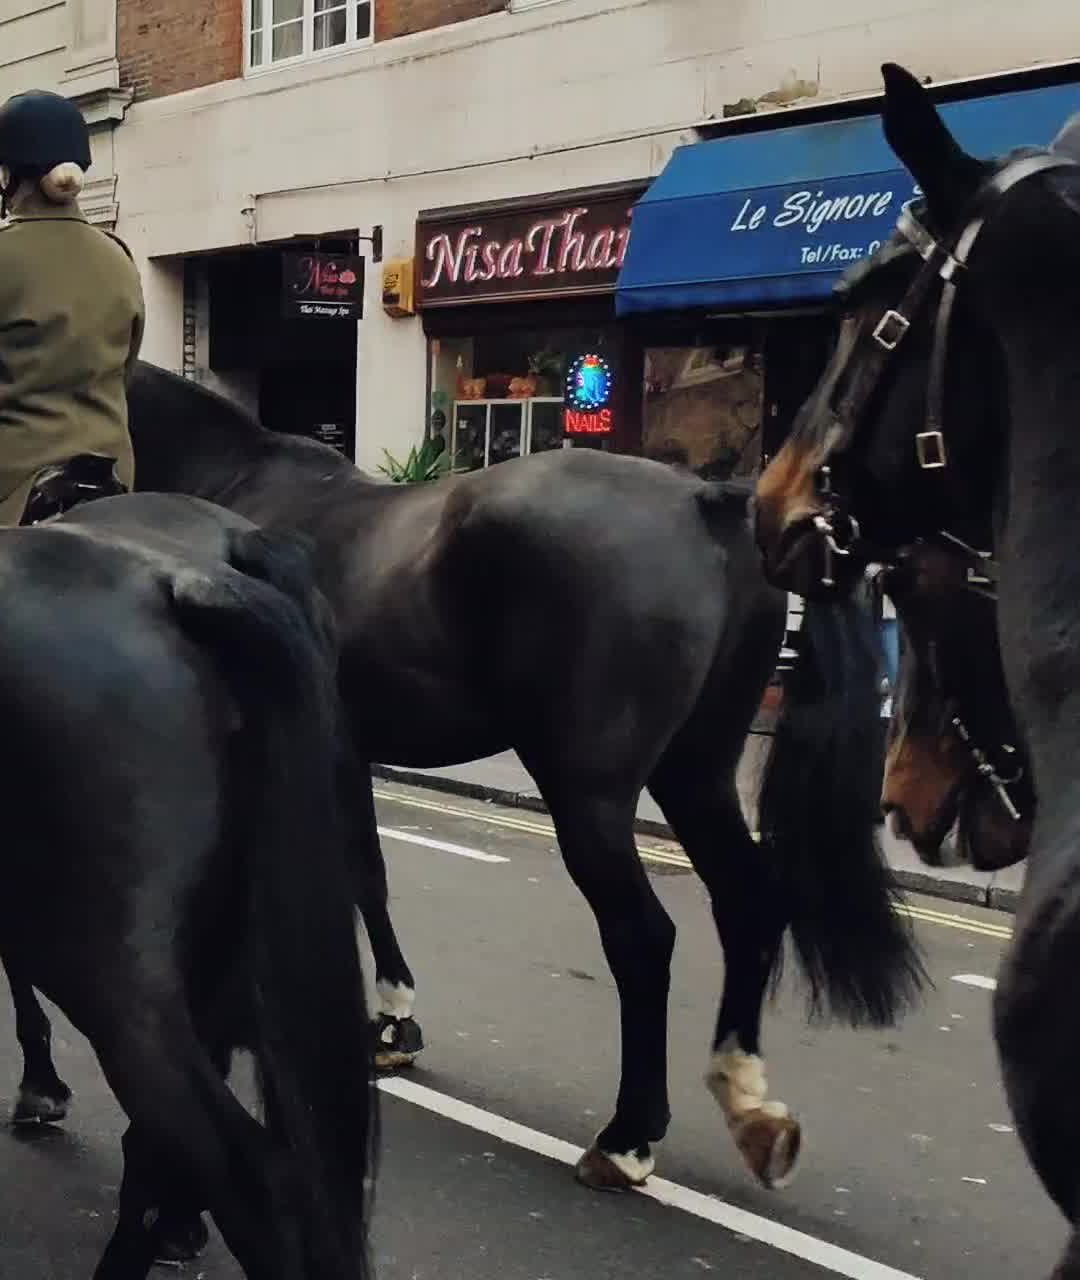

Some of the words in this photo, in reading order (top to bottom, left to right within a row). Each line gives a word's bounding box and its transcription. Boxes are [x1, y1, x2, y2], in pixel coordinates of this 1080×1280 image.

[730, 198, 767, 231] Le
[773, 191, 893, 232] Signore
[801, 243, 863, 263] Tel/Fax:
[566, 409, 611, 432] NAILS
